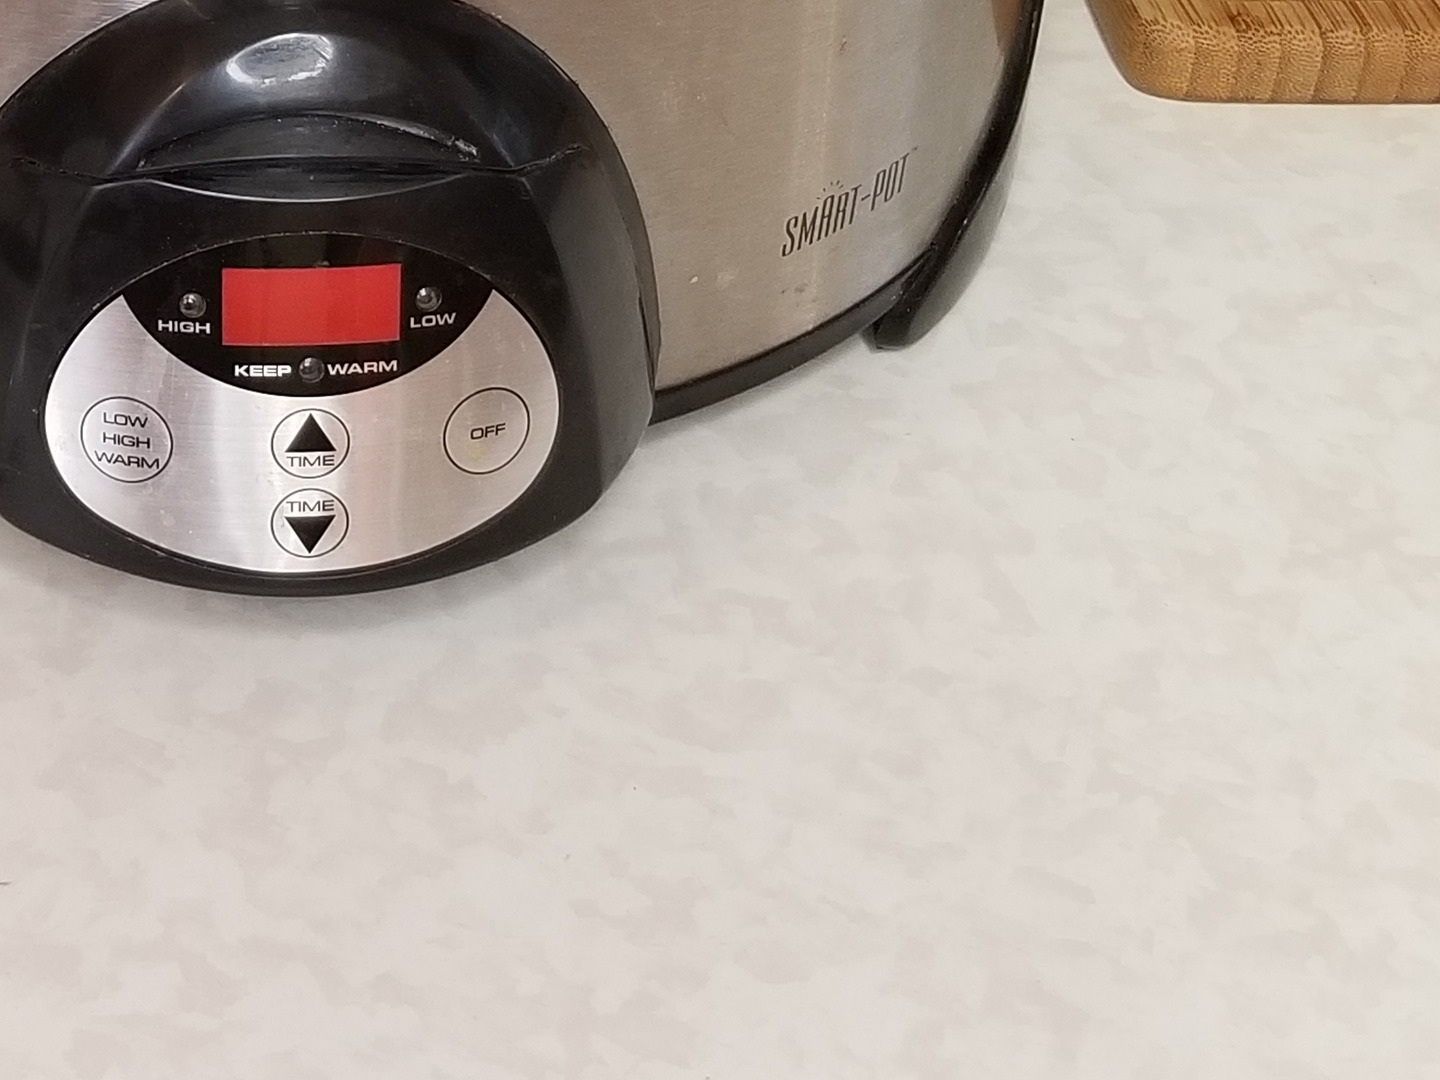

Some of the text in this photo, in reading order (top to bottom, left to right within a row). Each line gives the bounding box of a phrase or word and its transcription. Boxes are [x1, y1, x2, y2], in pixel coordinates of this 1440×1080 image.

[157, 320, 211, 335] HIGH
[409, 312, 456, 328] LOW
[234, 360, 398, 377] KEEP WARM
[102, 412, 148, 427] LOW
[470, 423, 507, 440] OFF
[102, 431, 150, 449] HIGH
[94, 451, 160, 469] WARM
[286, 455, 335, 467] TIME
[286, 500, 335, 512] TIME
